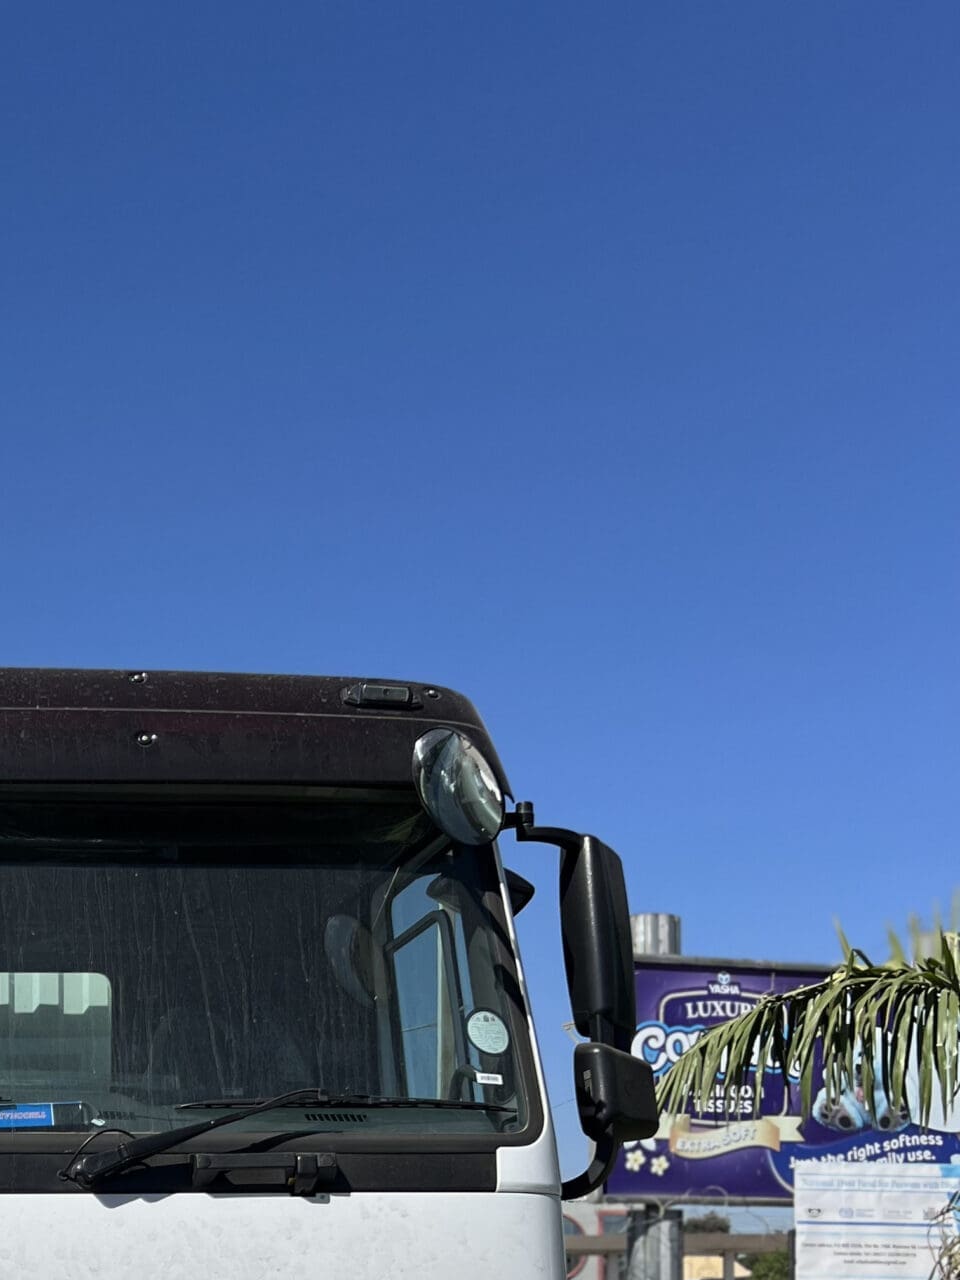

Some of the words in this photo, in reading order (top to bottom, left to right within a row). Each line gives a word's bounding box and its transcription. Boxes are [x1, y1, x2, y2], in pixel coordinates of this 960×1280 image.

[708, 983, 741, 995] YASHA
[847, 1141, 881, 1162] right
[883, 1133, 944, 1152] softness
[907, 1149, 937, 1162] use.
